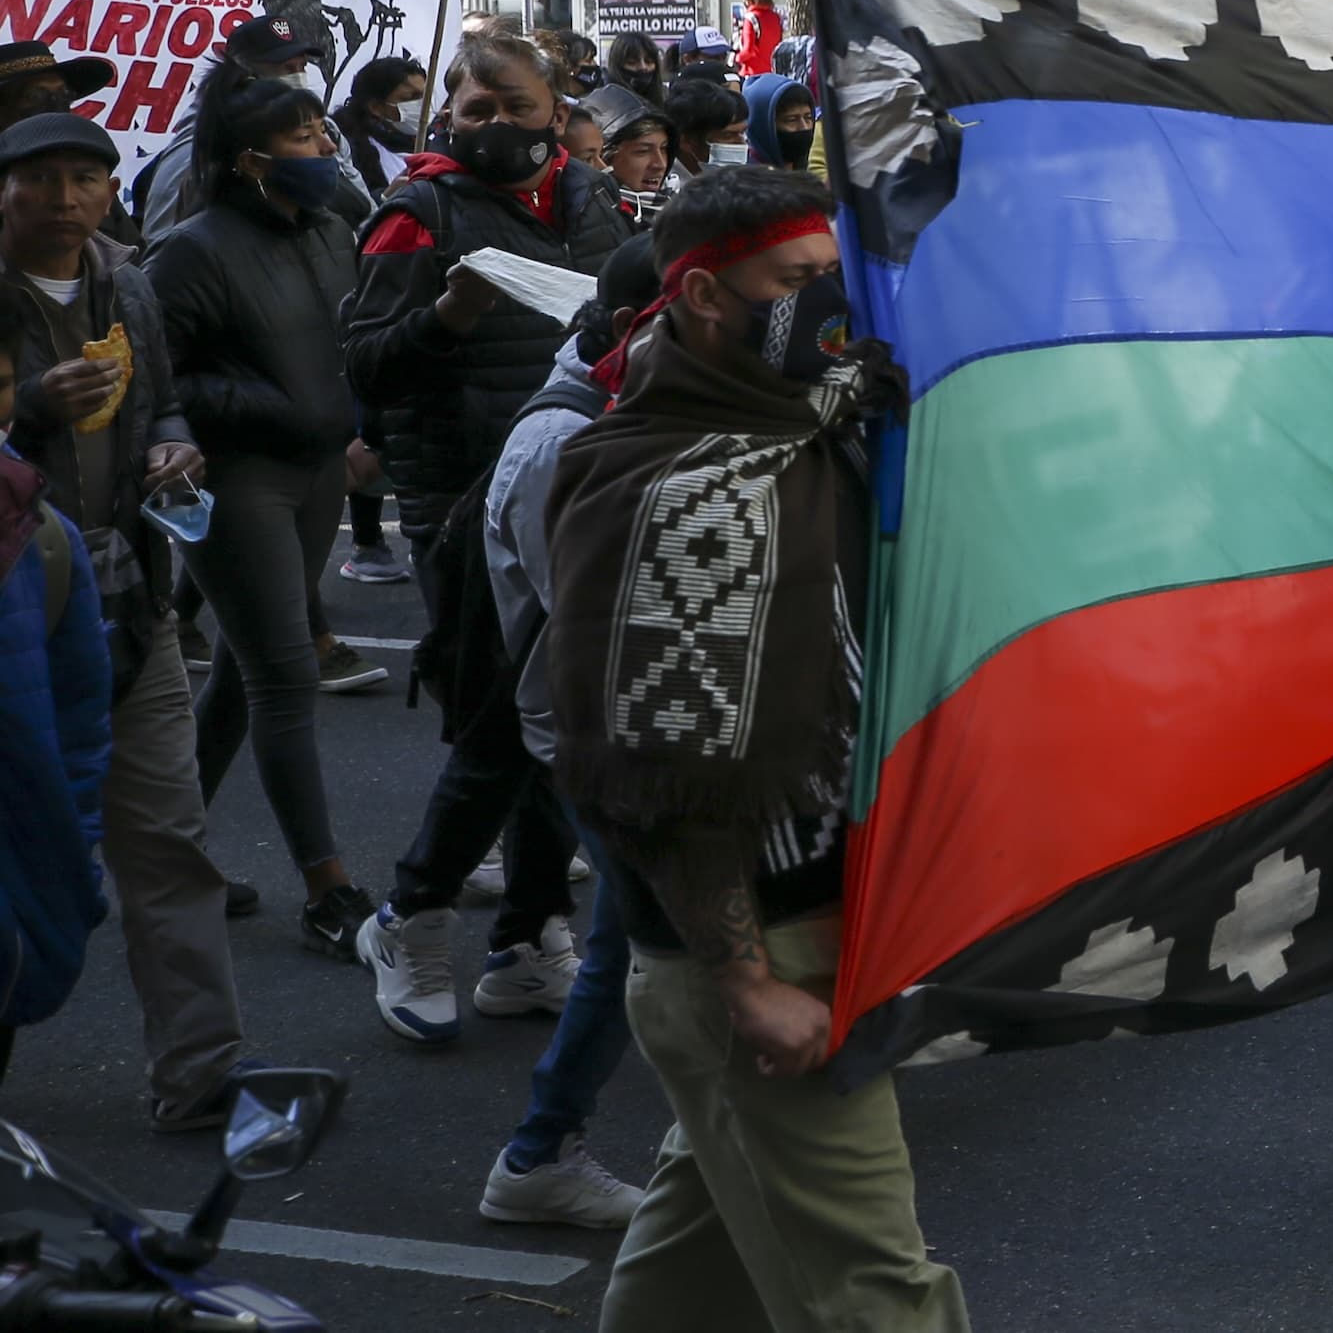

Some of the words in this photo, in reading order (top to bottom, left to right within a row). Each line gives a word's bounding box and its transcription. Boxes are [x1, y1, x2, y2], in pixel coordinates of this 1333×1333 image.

[600, 18, 642, 33] MACRI
[643, 18, 661, 32] LO
[663, 17, 695, 32] HIZO
